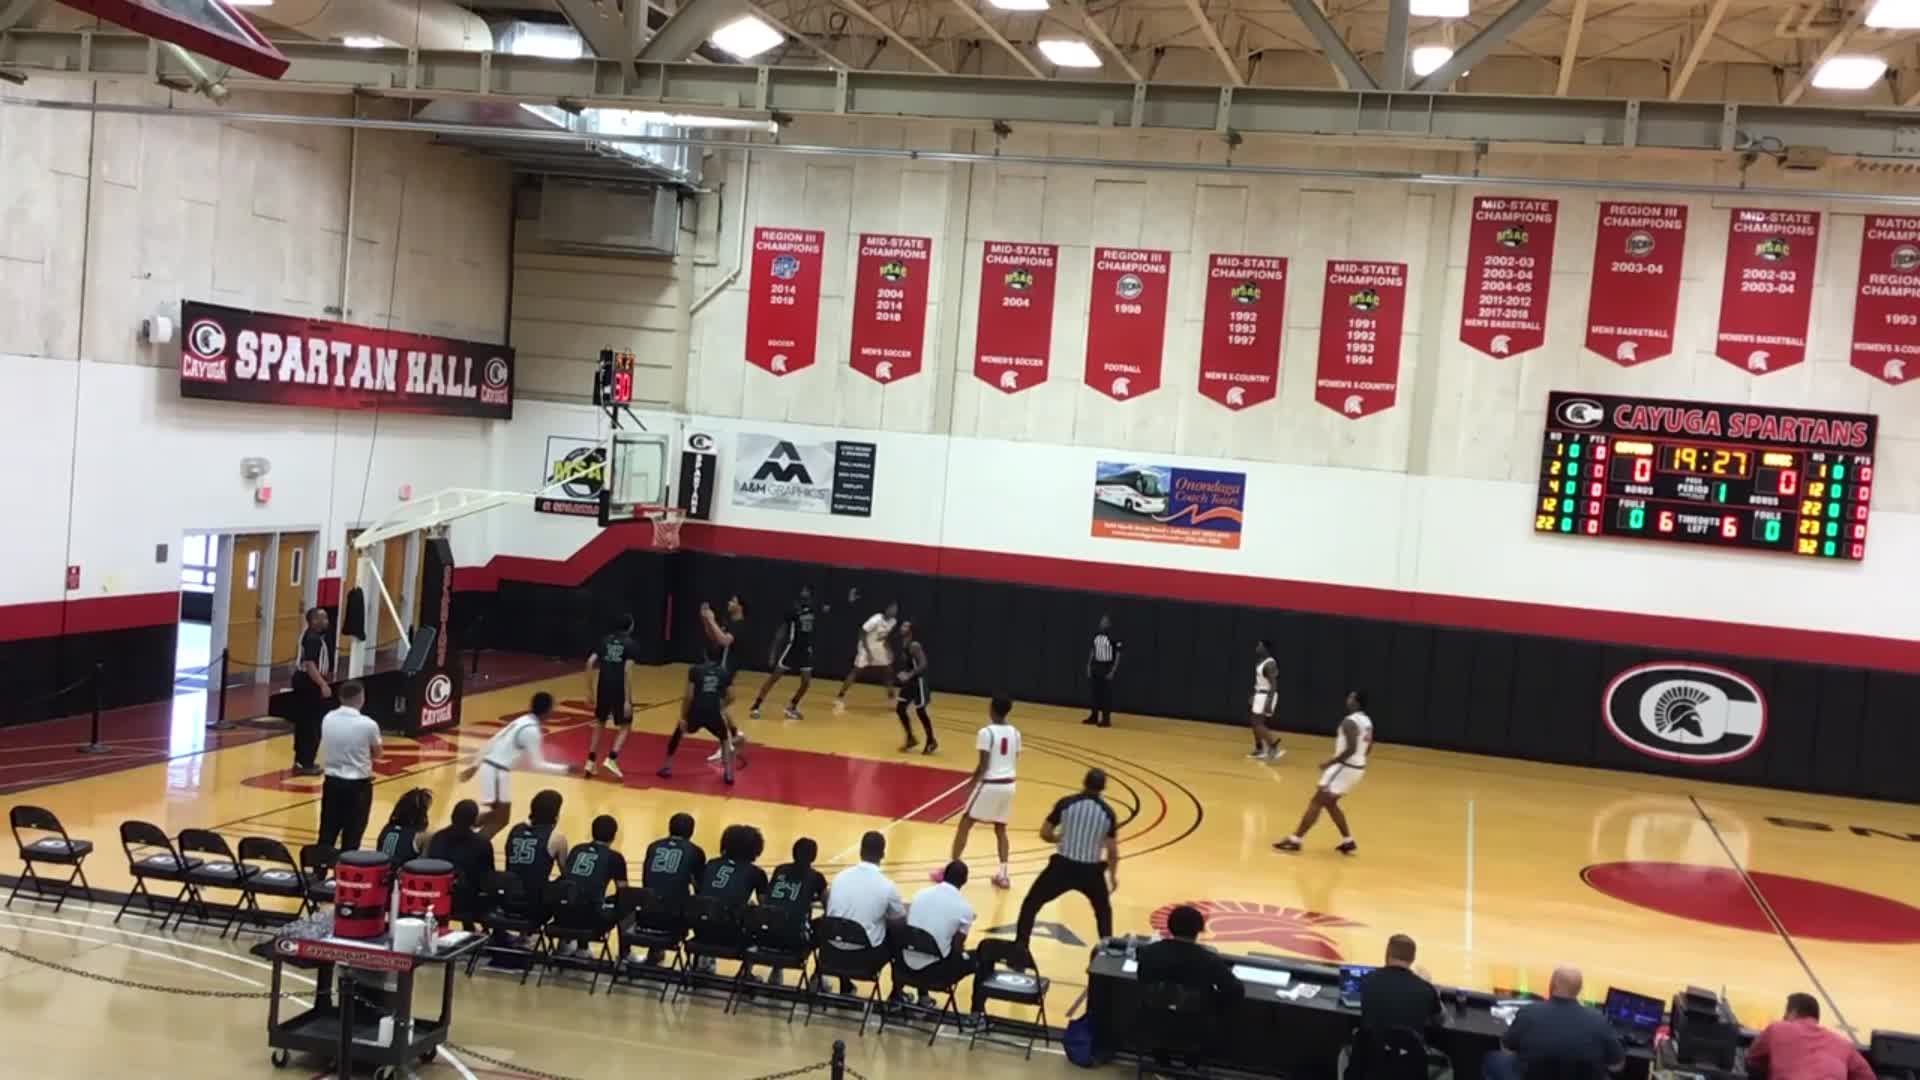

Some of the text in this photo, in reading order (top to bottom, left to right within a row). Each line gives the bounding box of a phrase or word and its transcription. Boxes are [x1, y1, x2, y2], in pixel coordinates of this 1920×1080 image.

[1481, 201, 1549, 212] MID-STATE
[1610, 205, 1677, 218] REGION III
[1476, 211, 1552, 223] CHAMPIONS
[1740, 211, 1811, 224] MID-STATE
[1603, 217, 1682, 230] CHAMPIONS
[1734, 223, 1815, 236] CHAMPIONS
[762, 231, 817, 242] REGION III
[756, 241, 820, 254] CHAMPIONS
[866, 237, 924, 249] MID-STATE
[861, 247, 927, 260] CHAMPIONS
[991, 244, 1050, 256] MID-STATE
[1103, 250, 1162, 262] REGION III
[986, 255, 1054, 267] CHAMPIONS
[1097, 261, 1167, 273] CHAMPIONS
[1216, 257, 1280, 269] MID-STATE
[1484, 256, 1535, 267] 2002-03
[1211, 268, 1283, 280] CHAMPIONS
[1334, 264, 1399, 275] MID-STATE
[1483, 268, 1533, 280] 2003-04
[1611, 262, 1663, 275] 2003-04
[1743, 268, 1796, 281] 2002-03
[1329, 274, 1403, 287] CHAMPIONS
[771, 284, 796, 294] 2014
[1481, 281, 1532, 293] 2004-05
[1741, 282, 1795, 294] 2003-04
[877, 289, 904, 299] 2004
[876, 301, 903, 311] 2014
[1003, 297, 1030, 307] 2004
[1114, 304, 1142, 314] 1998
[1230, 311, 1257, 321] 1992
[1885, 313, 1917, 326] 1993
[1229, 323, 1256, 333] 1993
[1349, 319, 1376, 329] 1991
[1490, 320, 1541, 331] BASKETBALL
[1347, 331, 1375, 341] 1992
[1616, 327, 1669, 338] BASKETBALL
[768, 339, 795, 347] SOCCER
[1228, 335, 1255, 345] 1997
[1756, 335, 1804, 346] BASKETBALL
[884, 349, 912, 358] SOCCER
[1346, 342, 1375, 353] 1993
[235, 329, 477, 399] SPARTAN HALL
[1015, 357, 1044, 367] SOCCER
[1345, 354, 1373, 365] 1994
[182, 354, 228, 382] CAYUGA
[1104, 363, 1142, 374] FOOTBALL
[614, 373, 631, 401] 30
[481, 383, 509, 404] CAYUGA
[1614, 404, 1868, 448] CAYUGA SPARTANS
[1590, 435, 1606, 443] PTS
[1557, 443, 1563, 456] 1
[1569, 443, 1580, 458] 0
[1595, 445, 1606, 460] 0
[1673, 447, 1747, 475] 19:27
[1854, 456, 1871, 465] PTS
[1551, 461, 1604, 478] 2 0 0
[1634, 458, 1652, 483] 0
[1819, 464, 1872, 482] 1 0 0
[1175, 476, 1241, 497] Onondaga
[1549, 480, 1602, 497] 4 0 0
[1677, 483, 1709, 494] PERIOD
[1778, 470, 1797, 495] 0
[740, 482, 766, 494] A&M
[767, 485, 830, 500] GRAPHICS
[1624, 485, 1654, 495] BONUS
[1718, 482, 1728, 503] 1
[1808, 482, 1870, 501] 12 0 0
[1542, 498, 1600, 515] 12 0 0
[1618, 499, 1646, 509] FOULS
[1749, 495, 1779, 507] BONUS
[1754, 510, 1782, 521] FOULS
[1802, 501, 1867, 520] 22 0 0
[1535, 516, 1598, 534] 22 0 0
[1629, 509, 1644, 529] 0
[1658, 511, 1674, 532] 6
[1678, 514, 1720, 527] TIMEOUTS
[1687, 525, 1708, 535] LEFT
[1722, 516, 1738, 538] 6
[1765, 520, 1781, 542] 0
[1799, 520, 1865, 539] 23 0 0
[1798, 539, 1863, 558] 32 0 0
[421, 702, 453, 728] CAYUGA
[509, 837, 538, 864] 35
[571, 851, 599, 877] 15
[651, 847, 682, 873] 20
[711, 865, 735, 888] 5
